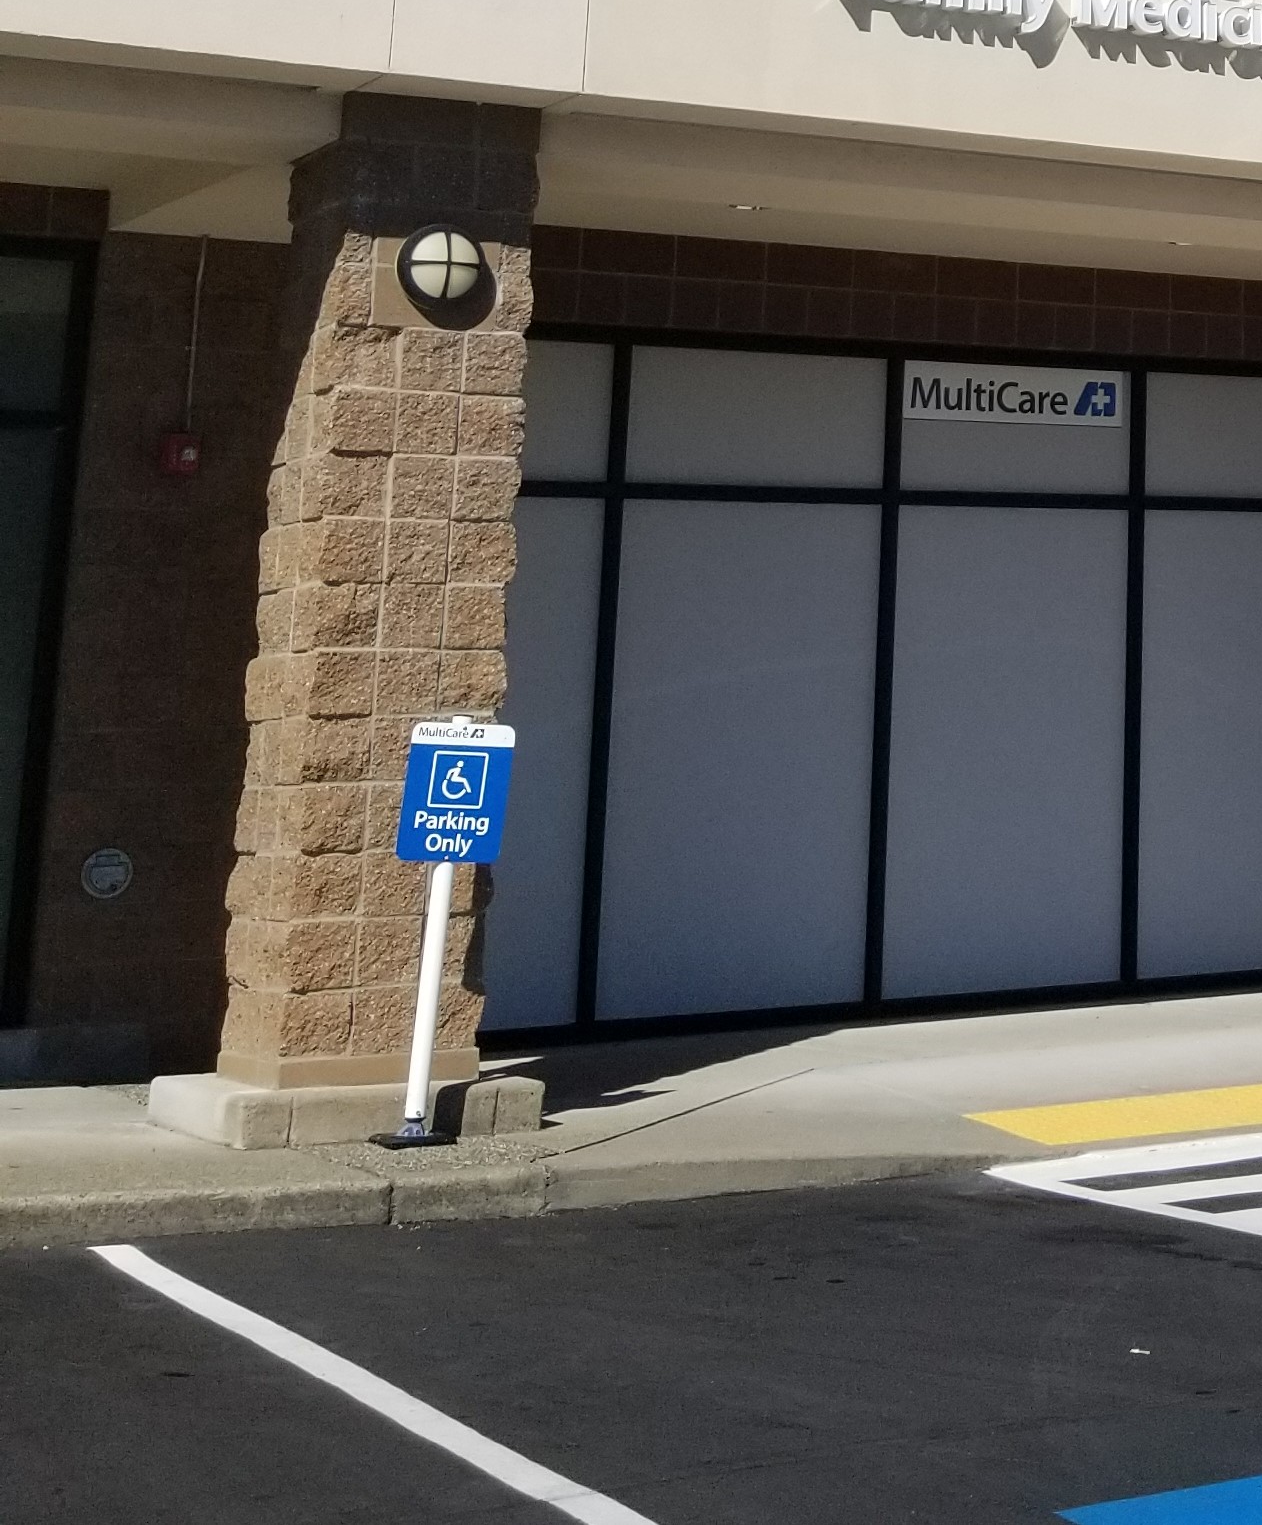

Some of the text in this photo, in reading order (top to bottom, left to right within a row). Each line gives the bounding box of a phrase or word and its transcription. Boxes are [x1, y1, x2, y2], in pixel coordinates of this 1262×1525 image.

[910, 376, 1069, 416] MultiCare
[418, 726, 470, 739] MultiCare
[413, 810, 490, 836] Parking
[425, 833, 473, 858] Only
